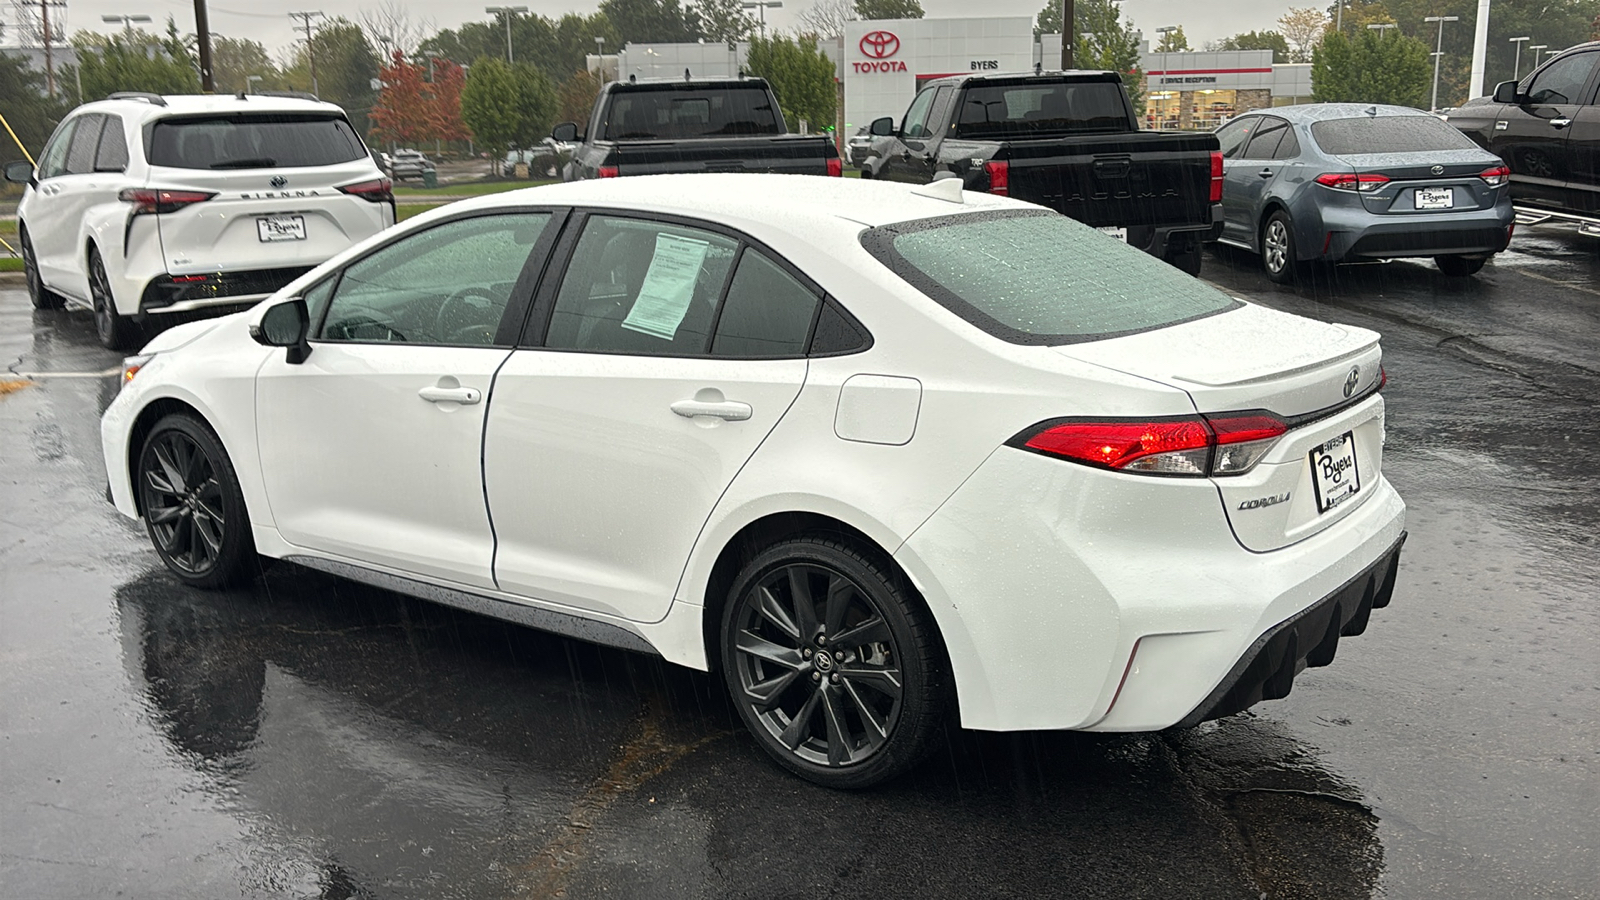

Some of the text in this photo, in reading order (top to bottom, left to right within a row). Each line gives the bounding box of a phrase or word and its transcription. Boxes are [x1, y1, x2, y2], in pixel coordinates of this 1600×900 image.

[852, 61, 907, 73] TOYOTA
[970, 60, 998, 70] BYERS
[240, 189, 320, 200] SIENNA
[1043, 189, 1179, 202] TACOMA
[1418, 192, 1450, 203] Byers
[1317, 454, 1352, 484] Byers
[1237, 491, 1290, 511] COROLLA
